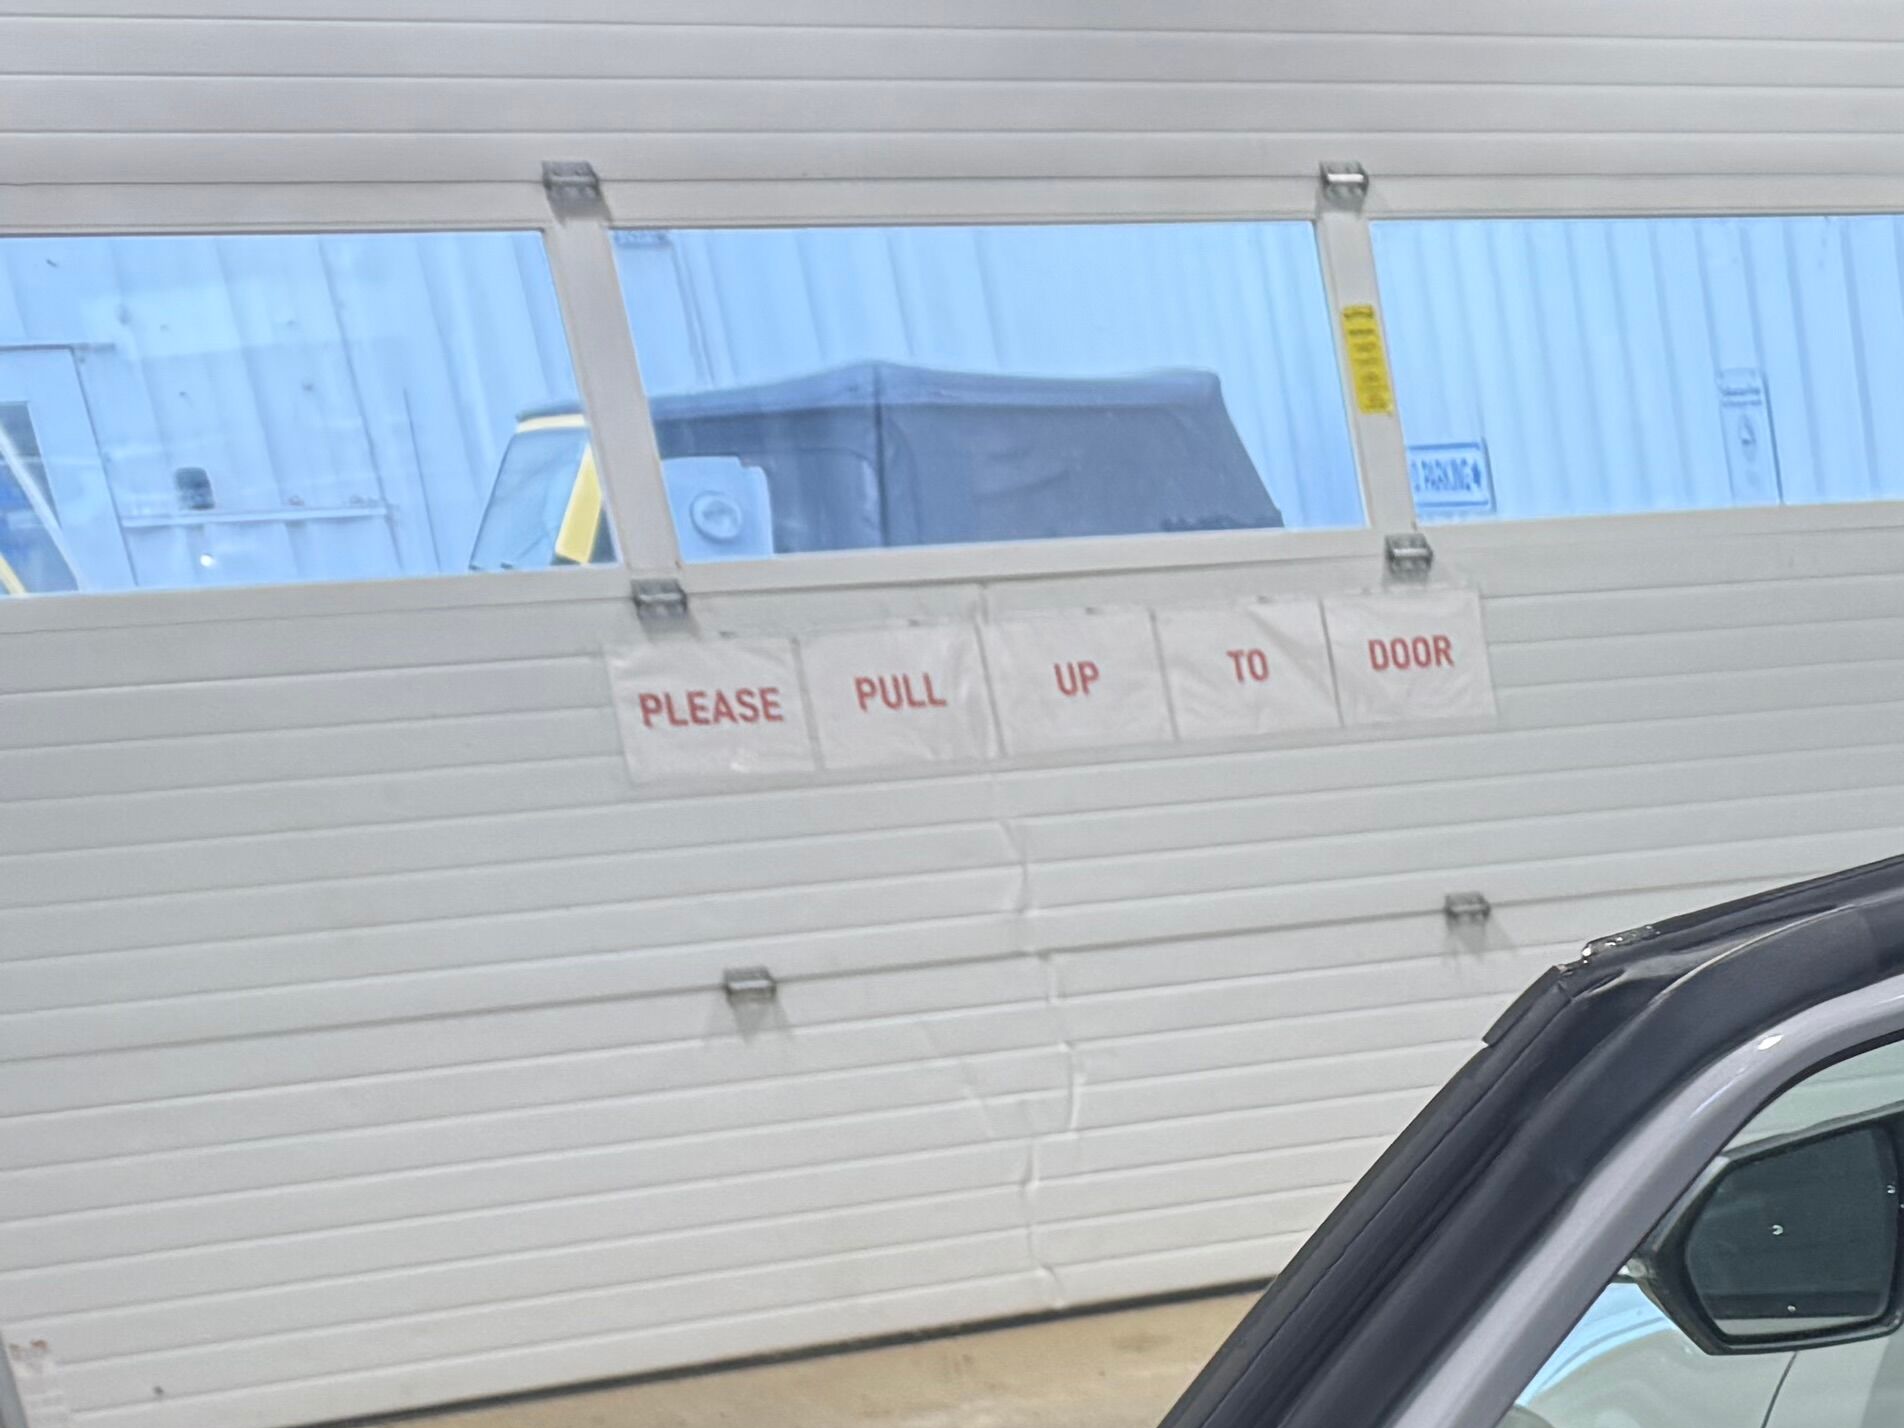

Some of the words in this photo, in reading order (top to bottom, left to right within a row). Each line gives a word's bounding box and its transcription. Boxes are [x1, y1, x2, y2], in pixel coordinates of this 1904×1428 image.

[639, 686, 785, 729] PLEASE
[853, 671, 947, 712] PULL
[1053, 660, 1101, 698] UP
[1226, 648, 1269, 684] TO
[1367, 634, 1454, 673] DOOR
